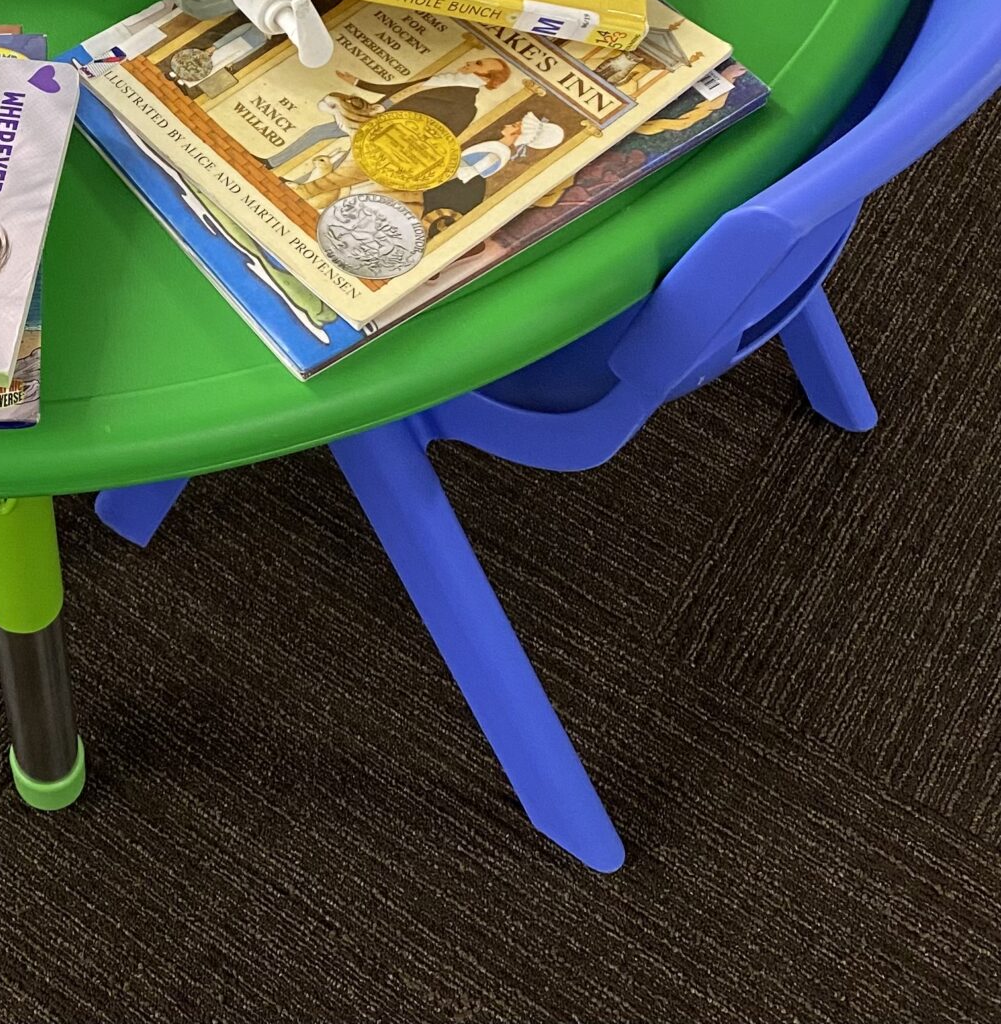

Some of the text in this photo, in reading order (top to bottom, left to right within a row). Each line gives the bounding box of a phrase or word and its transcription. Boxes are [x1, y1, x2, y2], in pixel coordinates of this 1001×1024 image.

[402, 14, 425, 36] FOR
[448, 1, 503, 20] BUNCH
[531, 17, 564, 35] M
[344, 23, 411, 77] EXPERIENCED
[373, 10, 431, 56] INNOCENT
[376, 32, 402, 51] AND
[335, 33, 395, 82] TRAVELERS
[479, 20, 559, 73] AKE'S
[557, 71, 616, 113] INN
[250, 95, 297, 133] NANCY
[278, 96, 299, 112] BY
[233, 102, 286, 149] WILLARD
[101, 71, 362, 301] LLUSTRATED BY ALICE AND MARTIN PROVENSEN
[411, 219, 426, 255] HONOR
